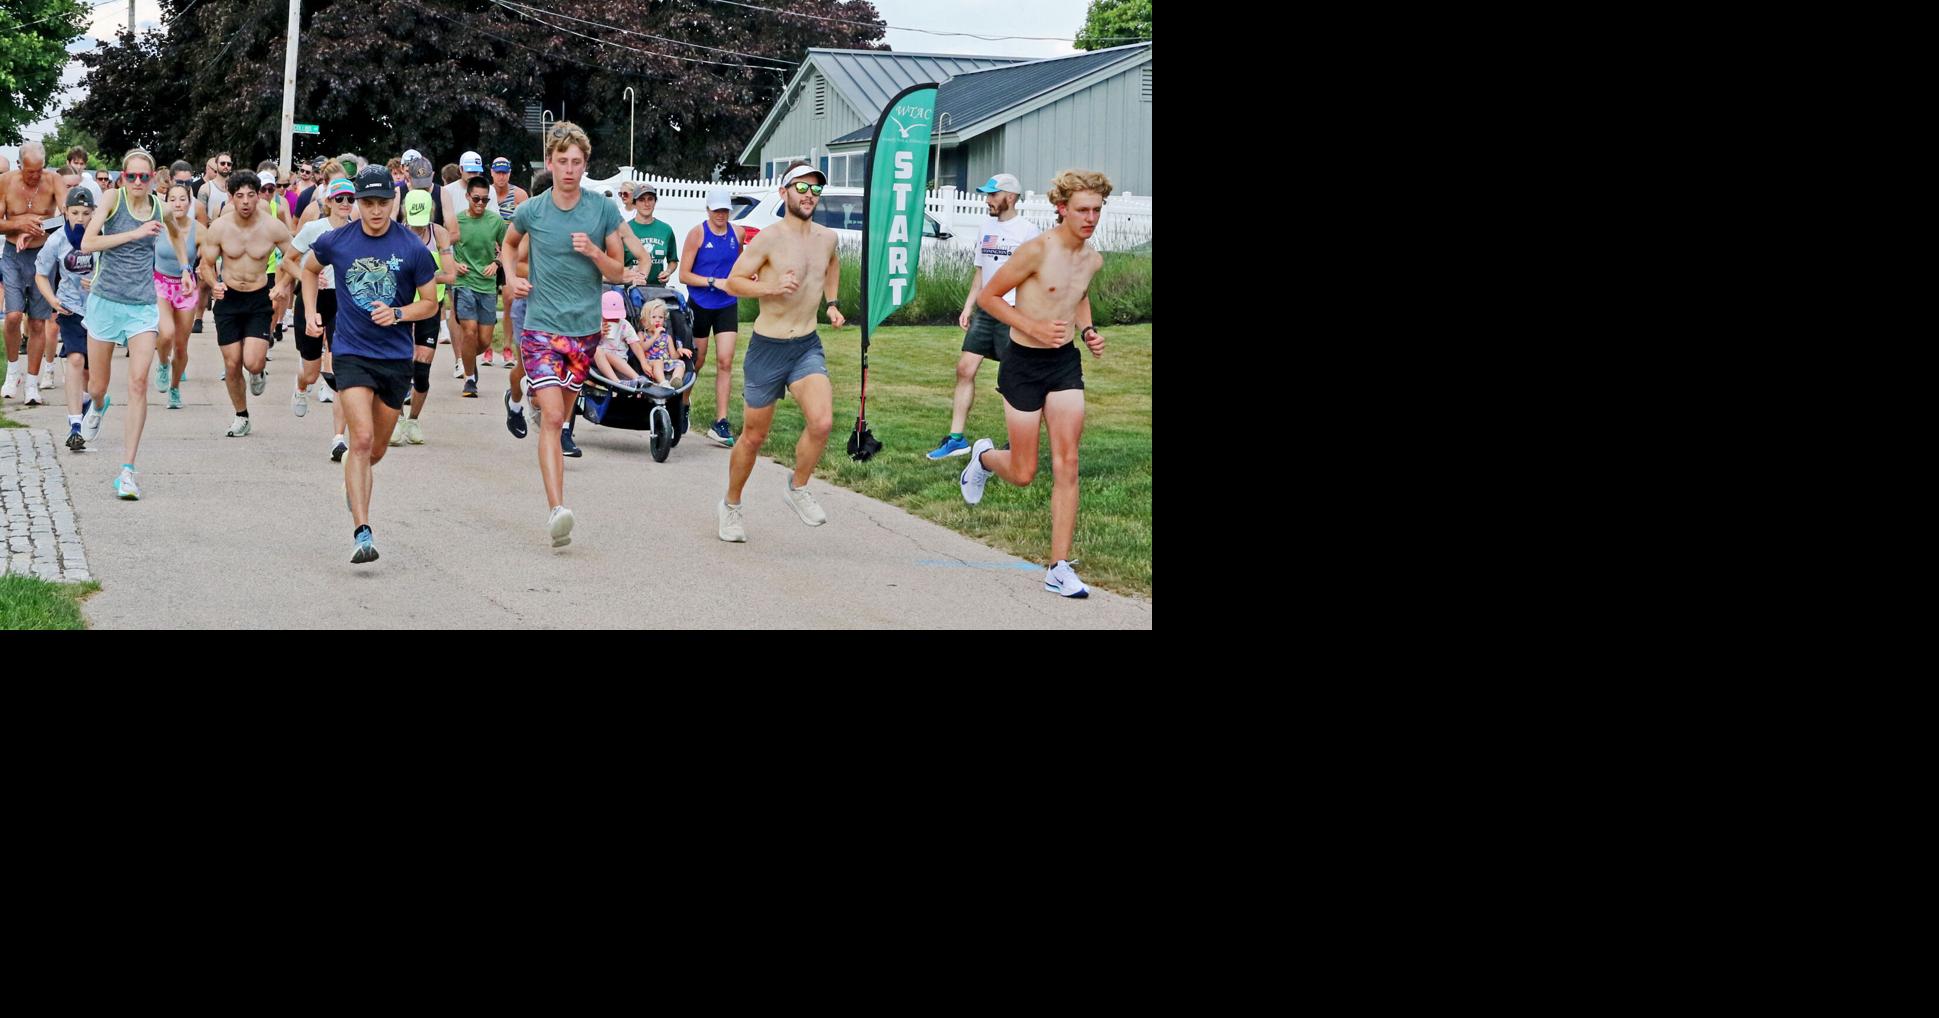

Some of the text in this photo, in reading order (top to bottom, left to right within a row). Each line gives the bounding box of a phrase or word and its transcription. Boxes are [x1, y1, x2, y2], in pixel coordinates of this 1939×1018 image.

[896, 105, 932, 120] WTAC
[411, 202, 426, 211] RUN
[888, 151, 914, 306] START
[640, 237, 665, 247] STERLY
